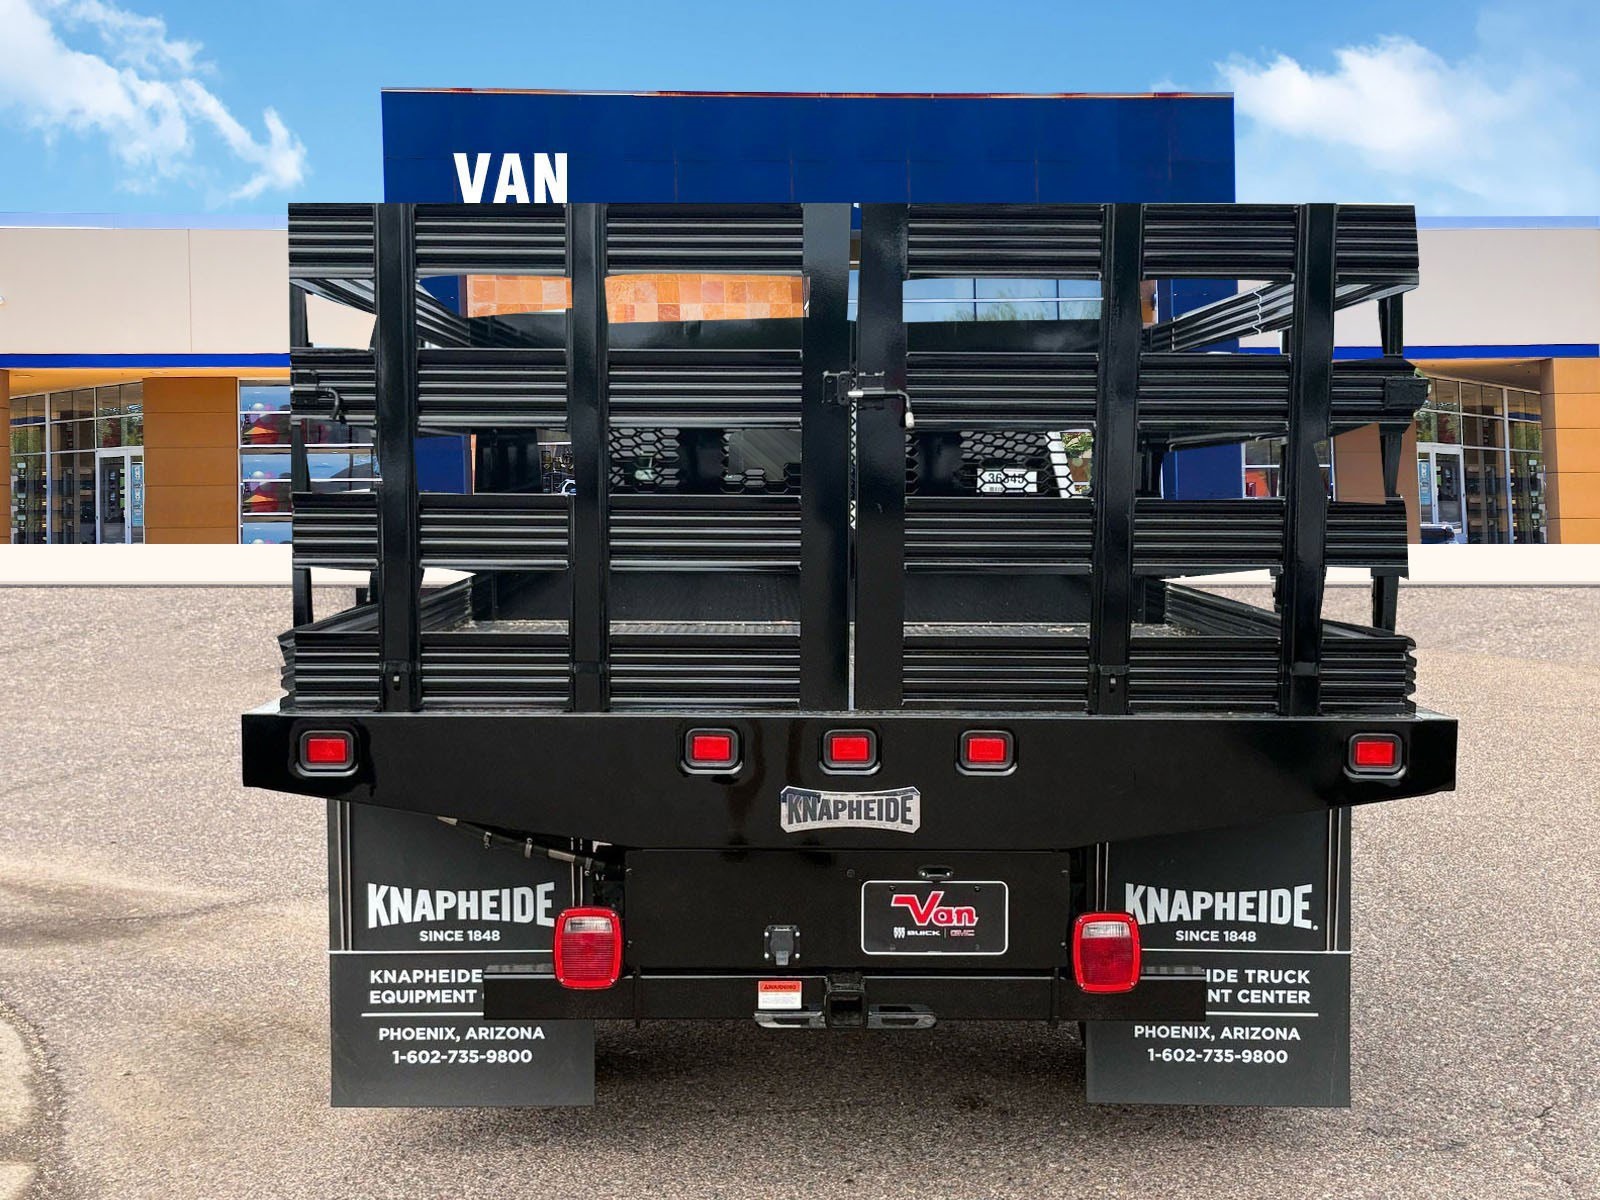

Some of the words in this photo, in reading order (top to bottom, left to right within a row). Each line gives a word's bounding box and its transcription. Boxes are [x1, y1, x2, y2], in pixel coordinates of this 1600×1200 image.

[453, 153, 568, 203] VAN
[786, 793, 914, 826] KNAPHEIDE
[367, 882, 556, 929] KNAPHEIDE
[891, 891, 979, 926] Van
[419, 930, 464, 942] SINCE
[467, 930, 501, 942] 1848
[1175, 930, 1220, 942] SINCE
[1223, 930, 1257, 942] 1848
[370, 969, 483, 984] KNAPHEIDE
[1245, 970, 1311, 984] TRUCK
[370, 989, 478, 1004] EQUIPMENT
[1237, 989, 1311, 1004] CENTER
[379, 1027, 461, 1042] PHOENIX,
[465, 1027, 545, 1040] ARIZONA
[1134, 1026, 1215, 1041] PHOENIX,
[1220, 1027, 1301, 1041] ARIZONA
[392, 1050, 533, 1064] 1-602-735-9800
[1147, 1049, 1288, 1063] 1-602-735-9800
